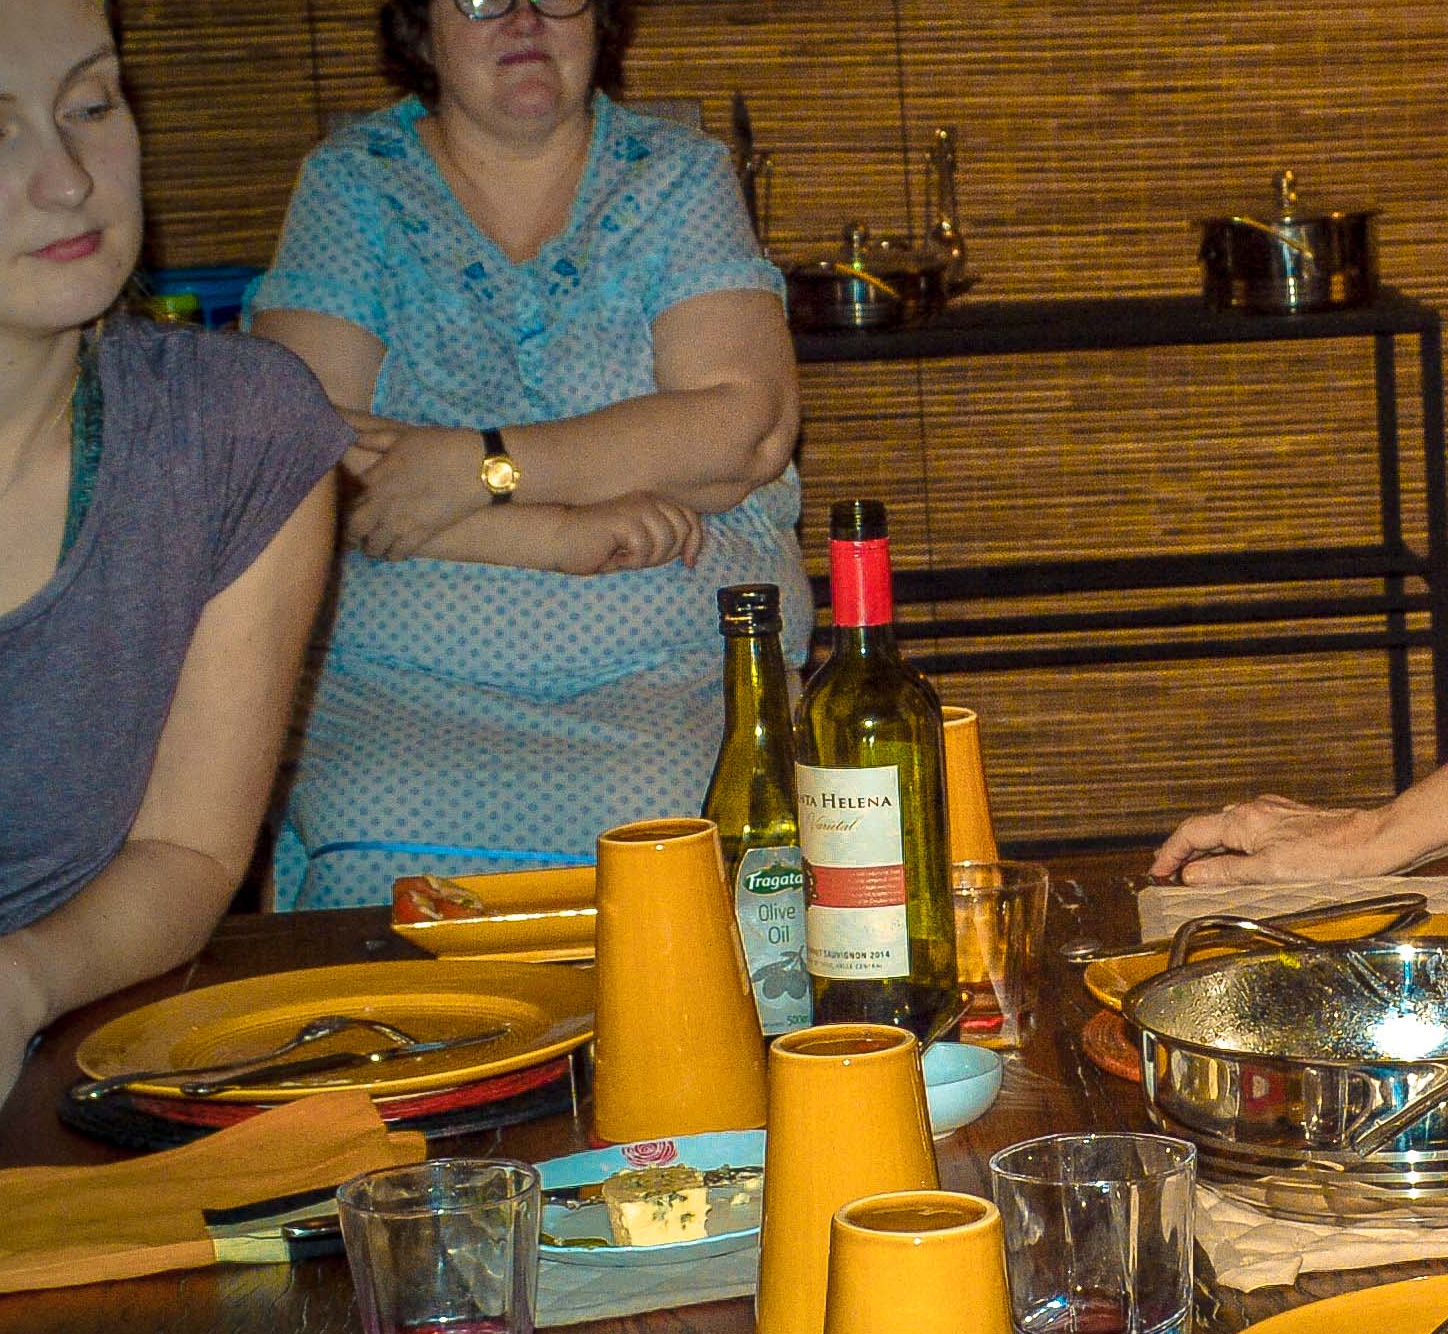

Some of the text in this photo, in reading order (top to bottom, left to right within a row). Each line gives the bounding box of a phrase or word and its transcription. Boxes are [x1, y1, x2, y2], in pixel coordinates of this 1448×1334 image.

[822, 793, 892, 808] HELENA
[746, 870, 804, 890] Fragata
[758, 903, 796, 922] Olive
[768, 925, 790, 945] Oil
[870, 950, 891, 959] 2014
